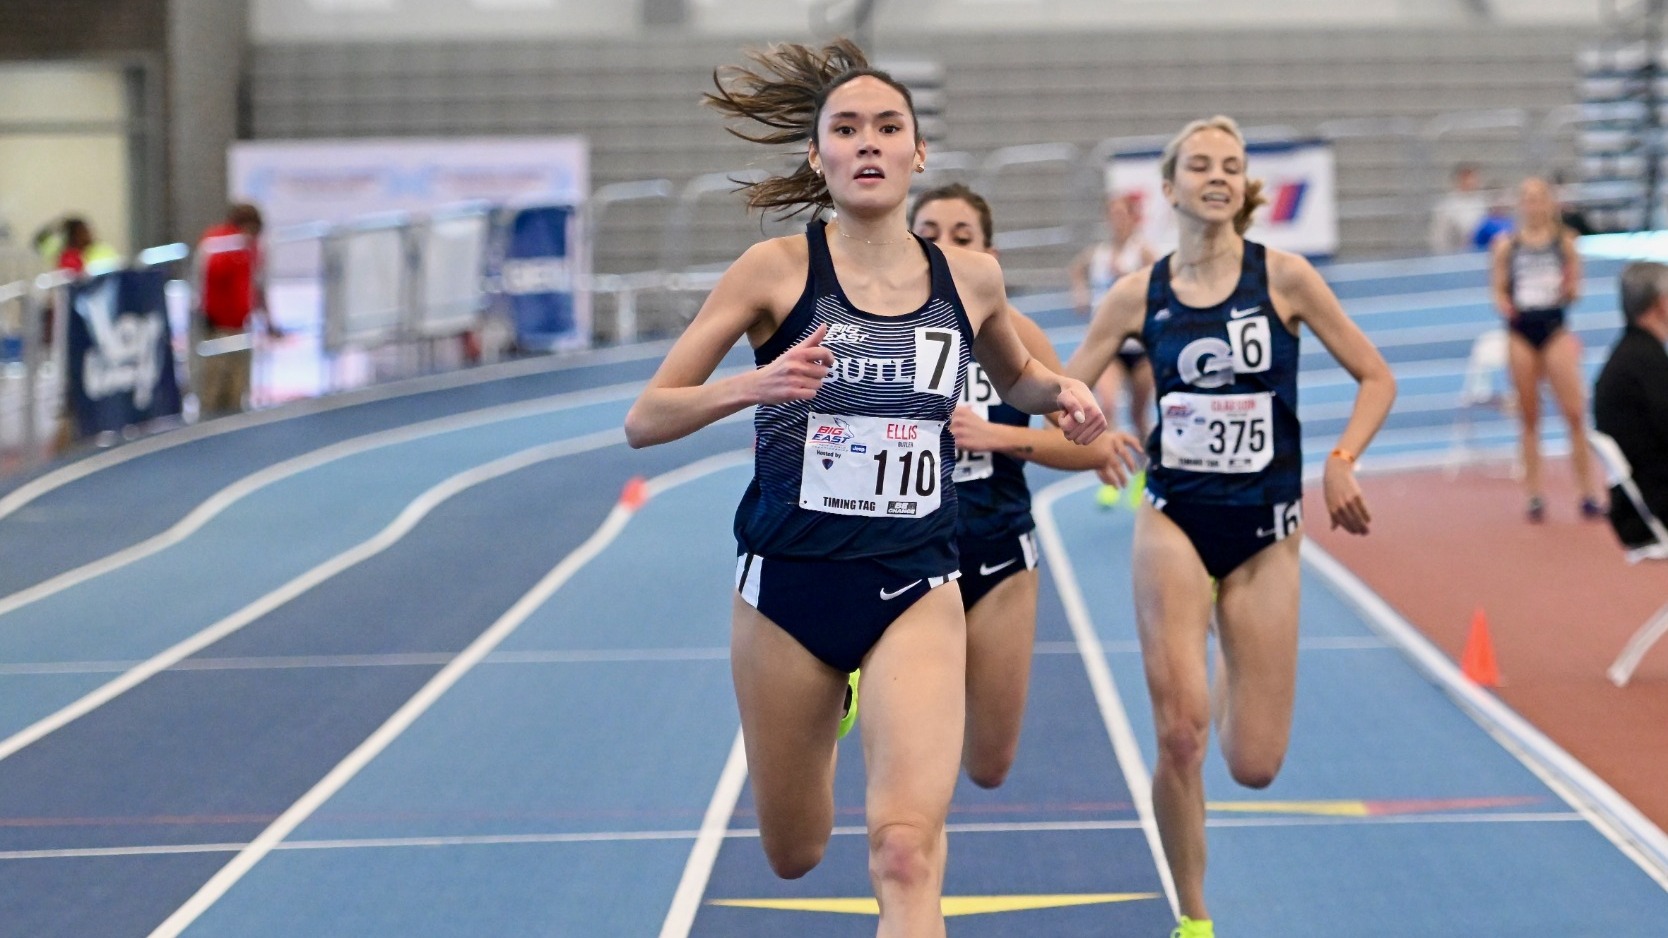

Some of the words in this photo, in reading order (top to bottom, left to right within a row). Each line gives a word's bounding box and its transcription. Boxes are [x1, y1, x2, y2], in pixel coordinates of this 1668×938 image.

[829, 323, 860, 334] BIG
[823, 332, 870, 343] EAST
[1240, 322, 1263, 368] 6
[925, 332, 952, 390] 7
[815, 357, 916, 384] BUTL
[817, 426, 844, 435] BIG
[887, 424, 917, 439] ELLIS
[1209, 419, 1265, 455] 375
[812, 434, 850, 443] EAST
[816, 449, 834, 457] Hosted
[834, 451, 842, 459] by
[873, 450, 935, 496] 110
[823, 496, 857, 510] TIMING
[857, 499, 876, 511] TAG
